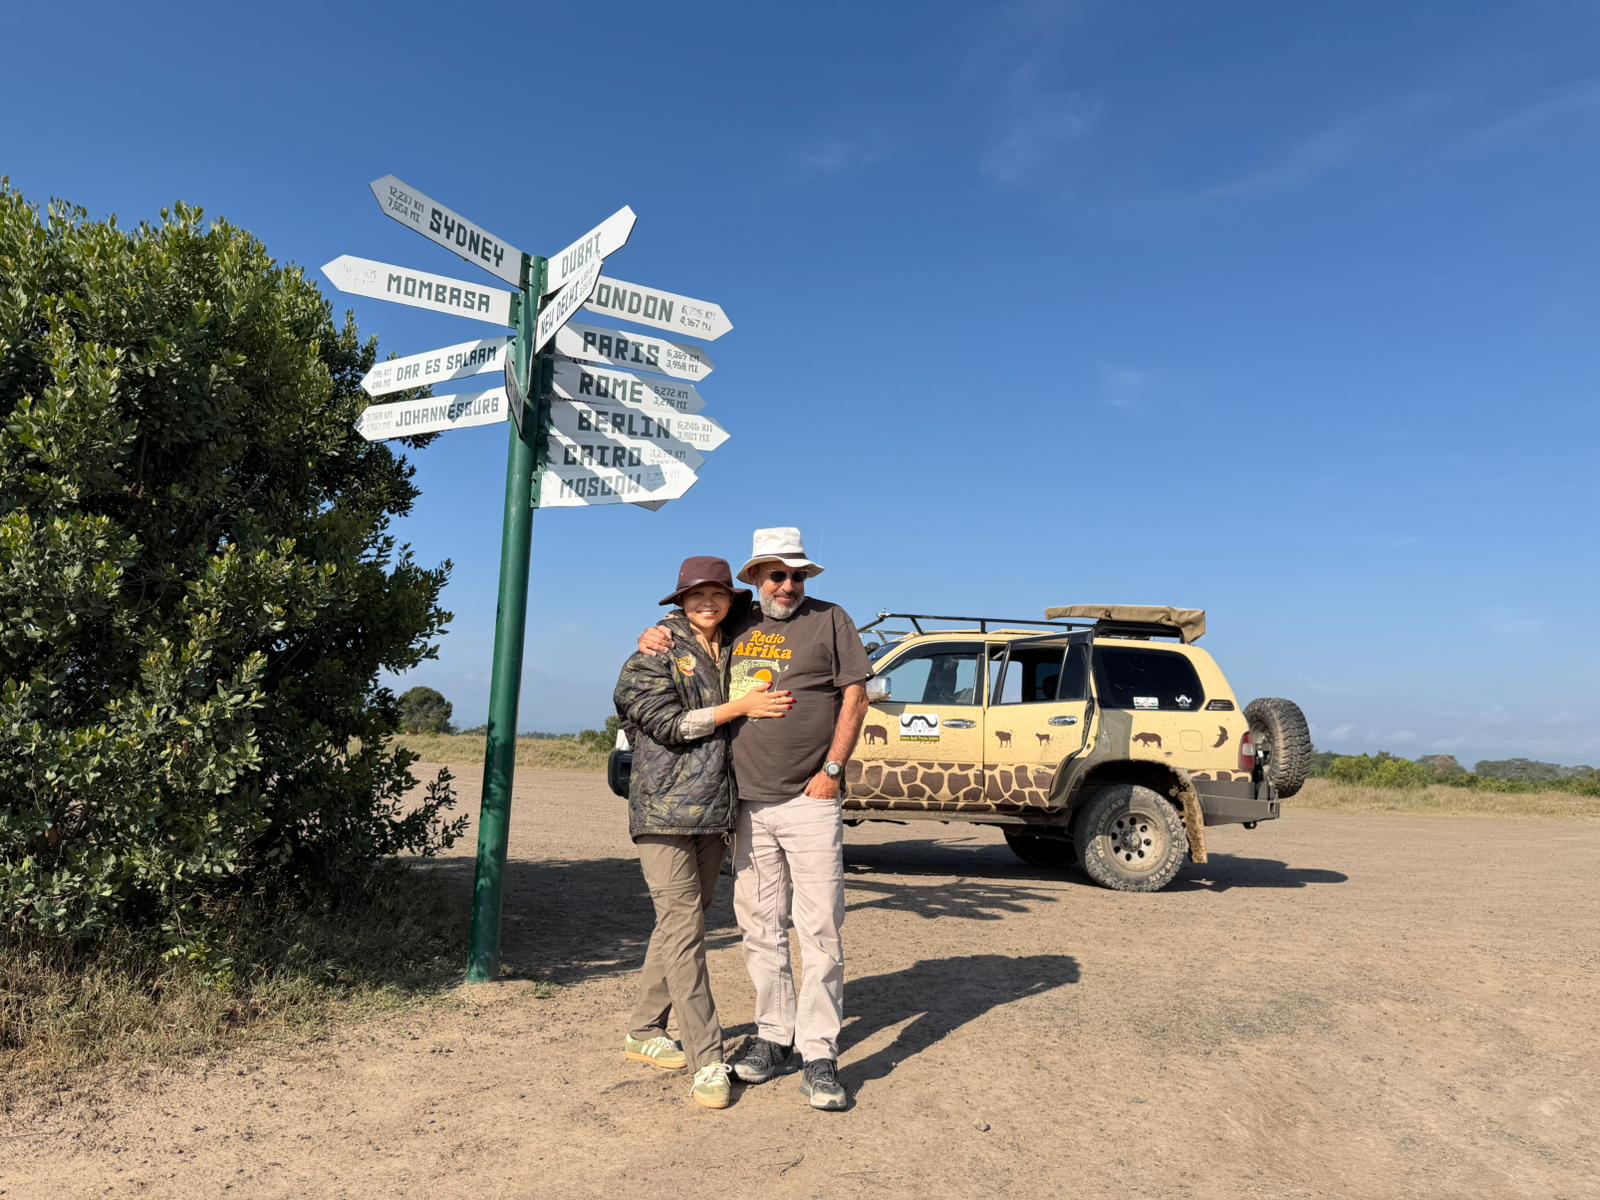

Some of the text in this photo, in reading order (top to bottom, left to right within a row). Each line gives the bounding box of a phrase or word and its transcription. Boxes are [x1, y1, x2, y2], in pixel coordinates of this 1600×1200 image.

[430, 207, 504, 268] SYDNEY
[561, 231, 602, 278] DUBAI
[387, 273, 490, 313] MOMBASA
[540, 279, 580, 340] NEW DELHI
[396, 346, 497, 381] DAR ES SALAAM
[583, 331, 660, 366] PARIS
[688, 364, 699, 373] MI
[579, 372, 643, 404] ROME
[677, 389, 688, 399] KM
[395, 397, 499, 427] JOHANNESBURG
[677, 400, 688, 410] MI
[578, 409, 671, 439] BERLIN
[564, 444, 642, 468] CAIRO
[560, 473, 642, 498] MOSCOW
[732, 641, 793, 660] Afrika
[750, 630, 786, 646] Radio
